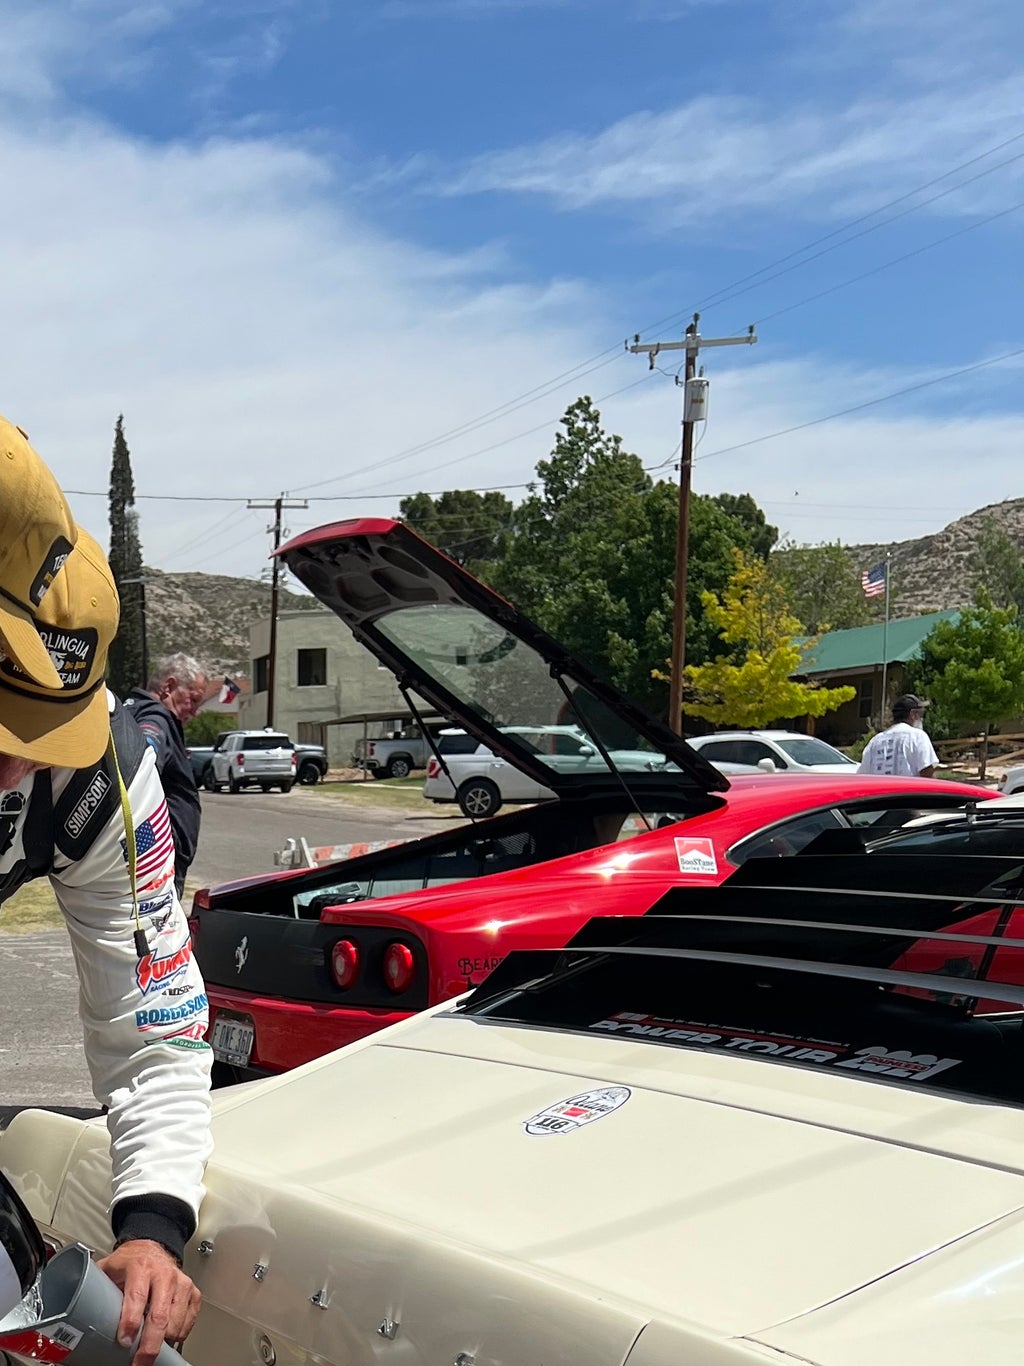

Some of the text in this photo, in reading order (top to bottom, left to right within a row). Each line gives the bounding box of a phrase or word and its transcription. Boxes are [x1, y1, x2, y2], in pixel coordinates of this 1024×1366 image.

[68, 775, 108, 834] SIMPSON
[588, 1020, 723, 1044] POWER
[724, 1036, 838, 1064] TOUR
